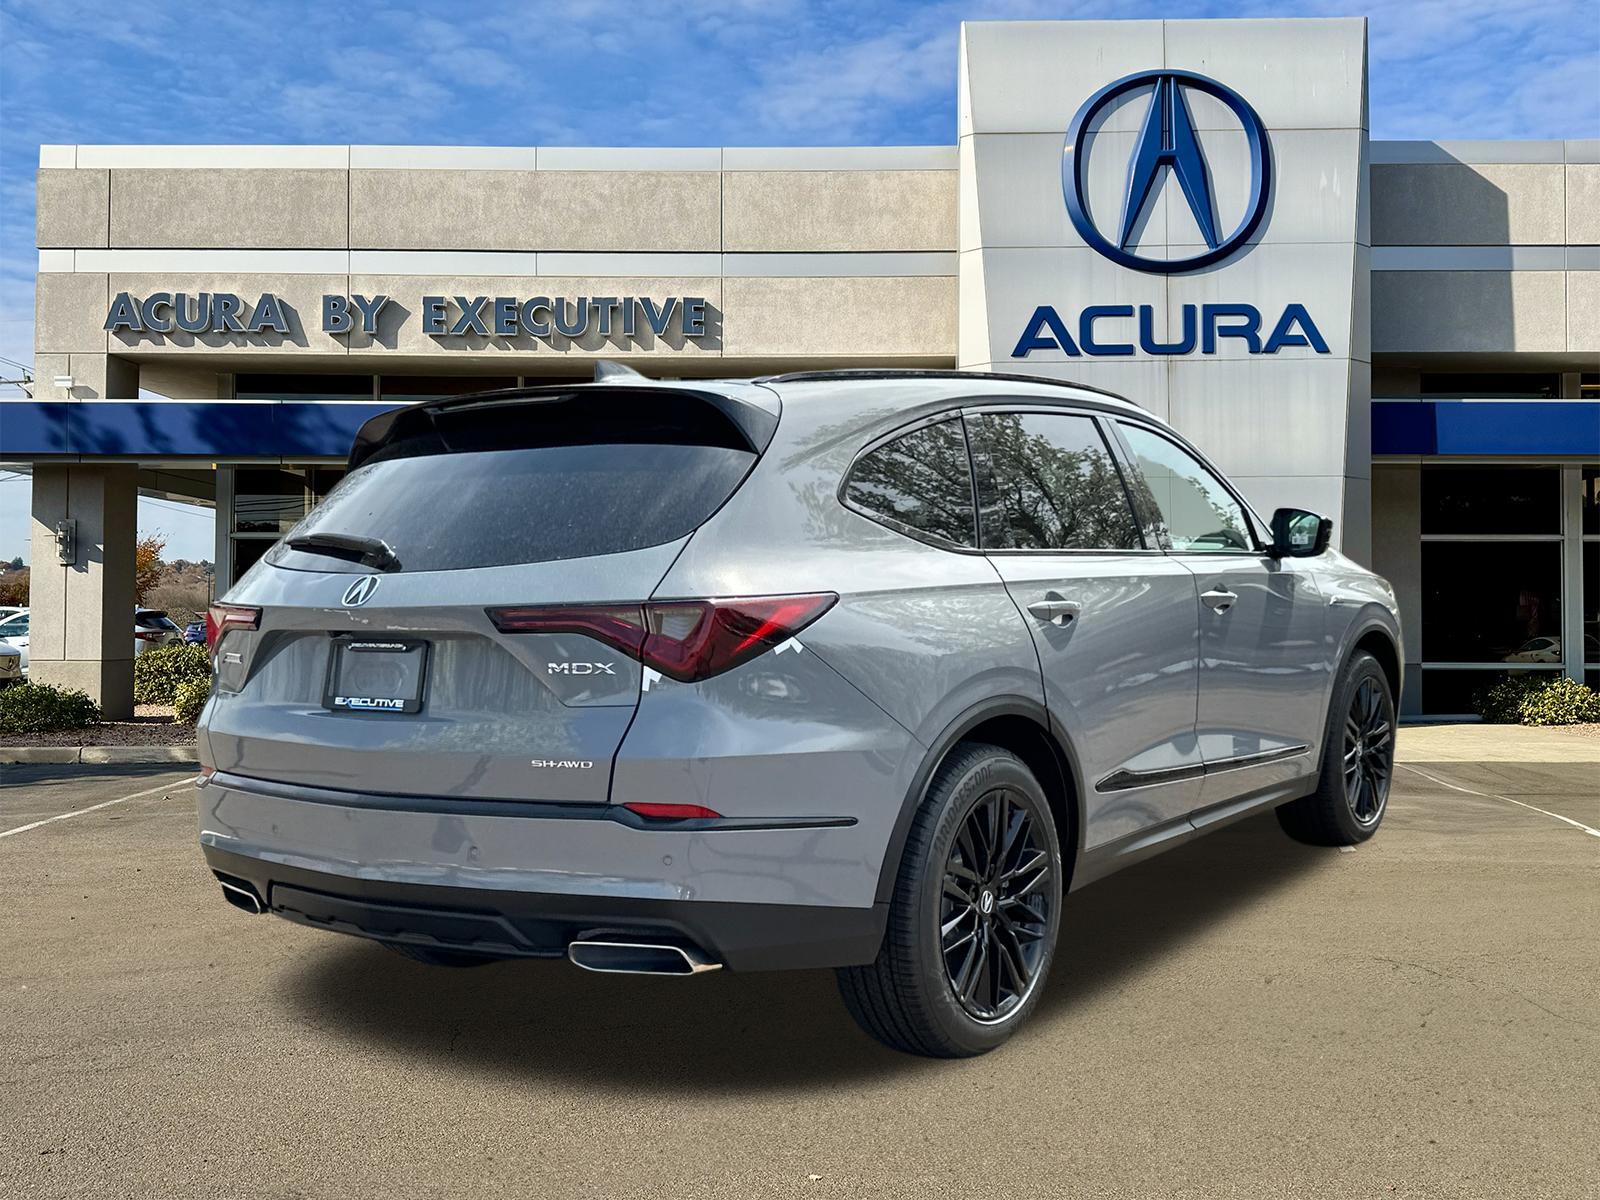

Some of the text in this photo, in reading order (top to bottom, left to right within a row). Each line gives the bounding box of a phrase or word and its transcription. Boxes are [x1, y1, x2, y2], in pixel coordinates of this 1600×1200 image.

[104, 293, 707, 339] ACURA BY EXECUTIVE
[1011, 304, 1332, 357] ACURA
[547, 662, 616, 675] MDX
[334, 697, 404, 708] EXECUTIVE
[933, 764, 993, 856] BRIDGESTONE
